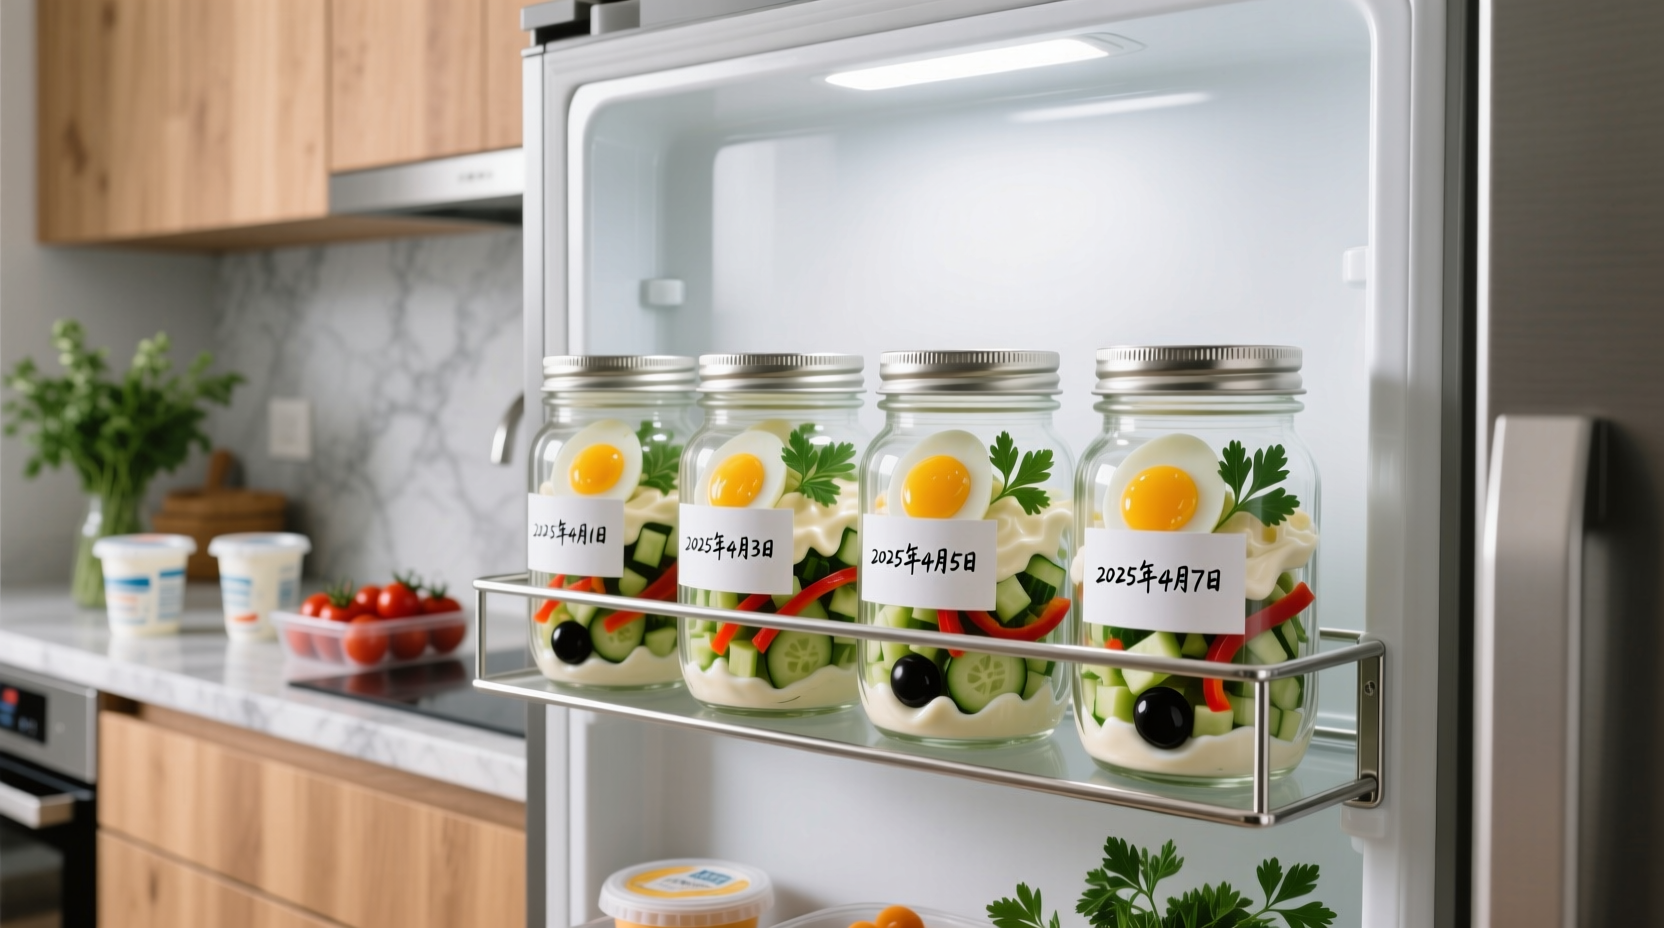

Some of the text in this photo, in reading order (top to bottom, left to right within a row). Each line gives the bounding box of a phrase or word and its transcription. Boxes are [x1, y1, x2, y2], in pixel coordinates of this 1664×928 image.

[684, 531, 775, 561] 2025年4月3日
[870, 542, 977, 576] 2025年4月5日
[1095, 559, 1222, 594] 2025年4月7日
